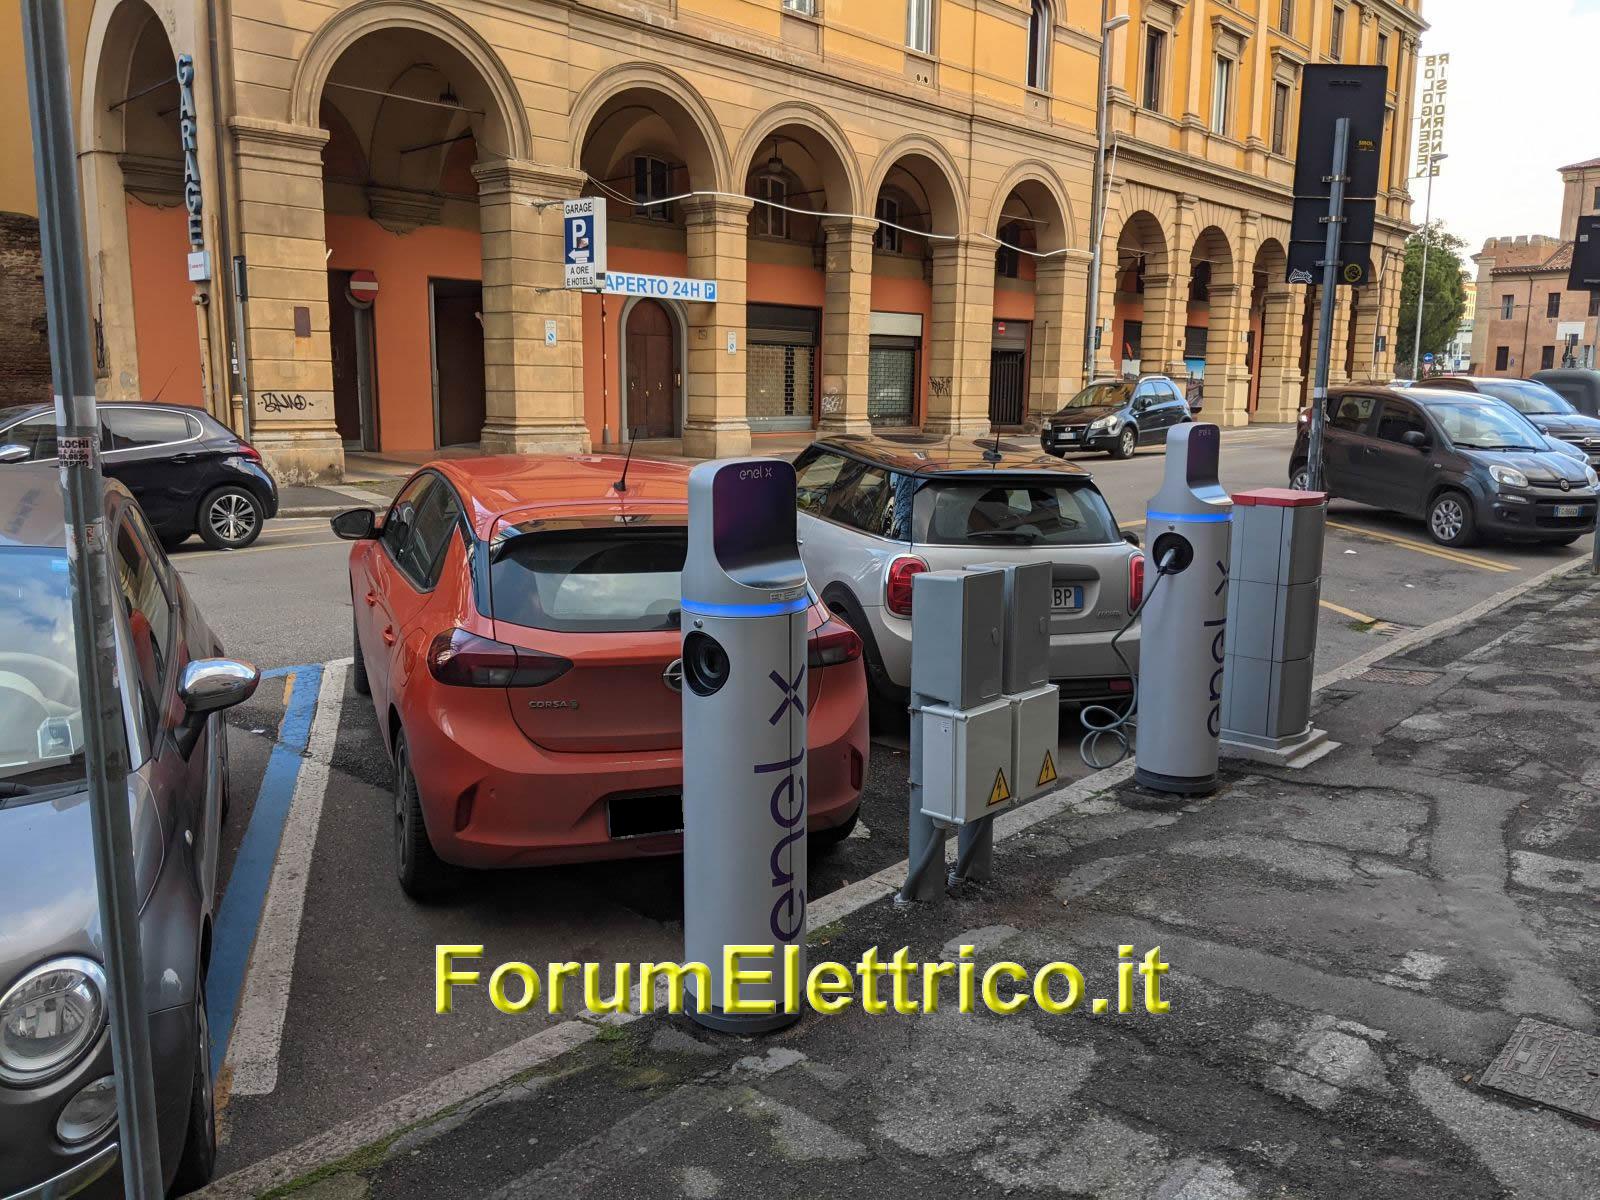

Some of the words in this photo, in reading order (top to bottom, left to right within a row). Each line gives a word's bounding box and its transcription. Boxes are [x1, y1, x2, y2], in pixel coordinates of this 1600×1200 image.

[176, 53, 204, 245] GARAGE
[565, 202, 592, 215] GARAGE
[572, 219, 587, 248] P
[576, 266, 589, 275] ORE
[571, 277, 593, 287] HOTELS
[605, 274, 668, 295] APERTO
[673, 281, 700, 298] 24H
[739, 466, 763, 481] enel
[528, 700, 568, 709] CORSA
[754, 747, 805, 942] enel
